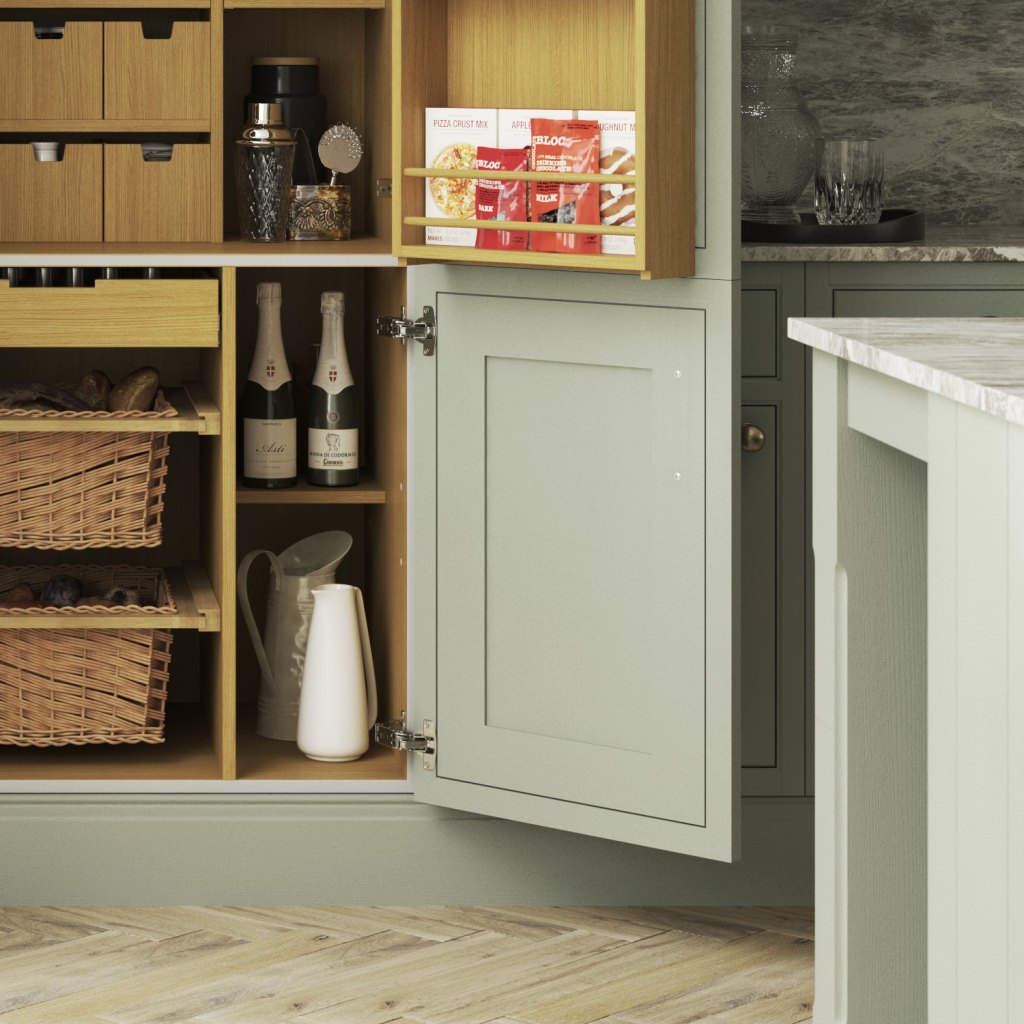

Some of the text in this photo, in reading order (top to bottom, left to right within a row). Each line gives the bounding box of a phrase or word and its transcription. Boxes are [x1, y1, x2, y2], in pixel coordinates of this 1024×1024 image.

[433, 119, 489, 129] PIZZA CRUST MIX
[599, 123, 627, 132] UGHNUT
[535, 135, 566, 146] BLOC
[478, 160, 502, 170] BLOC
[535, 194, 558, 203] MILK
[478, 204, 494, 213] DARK
